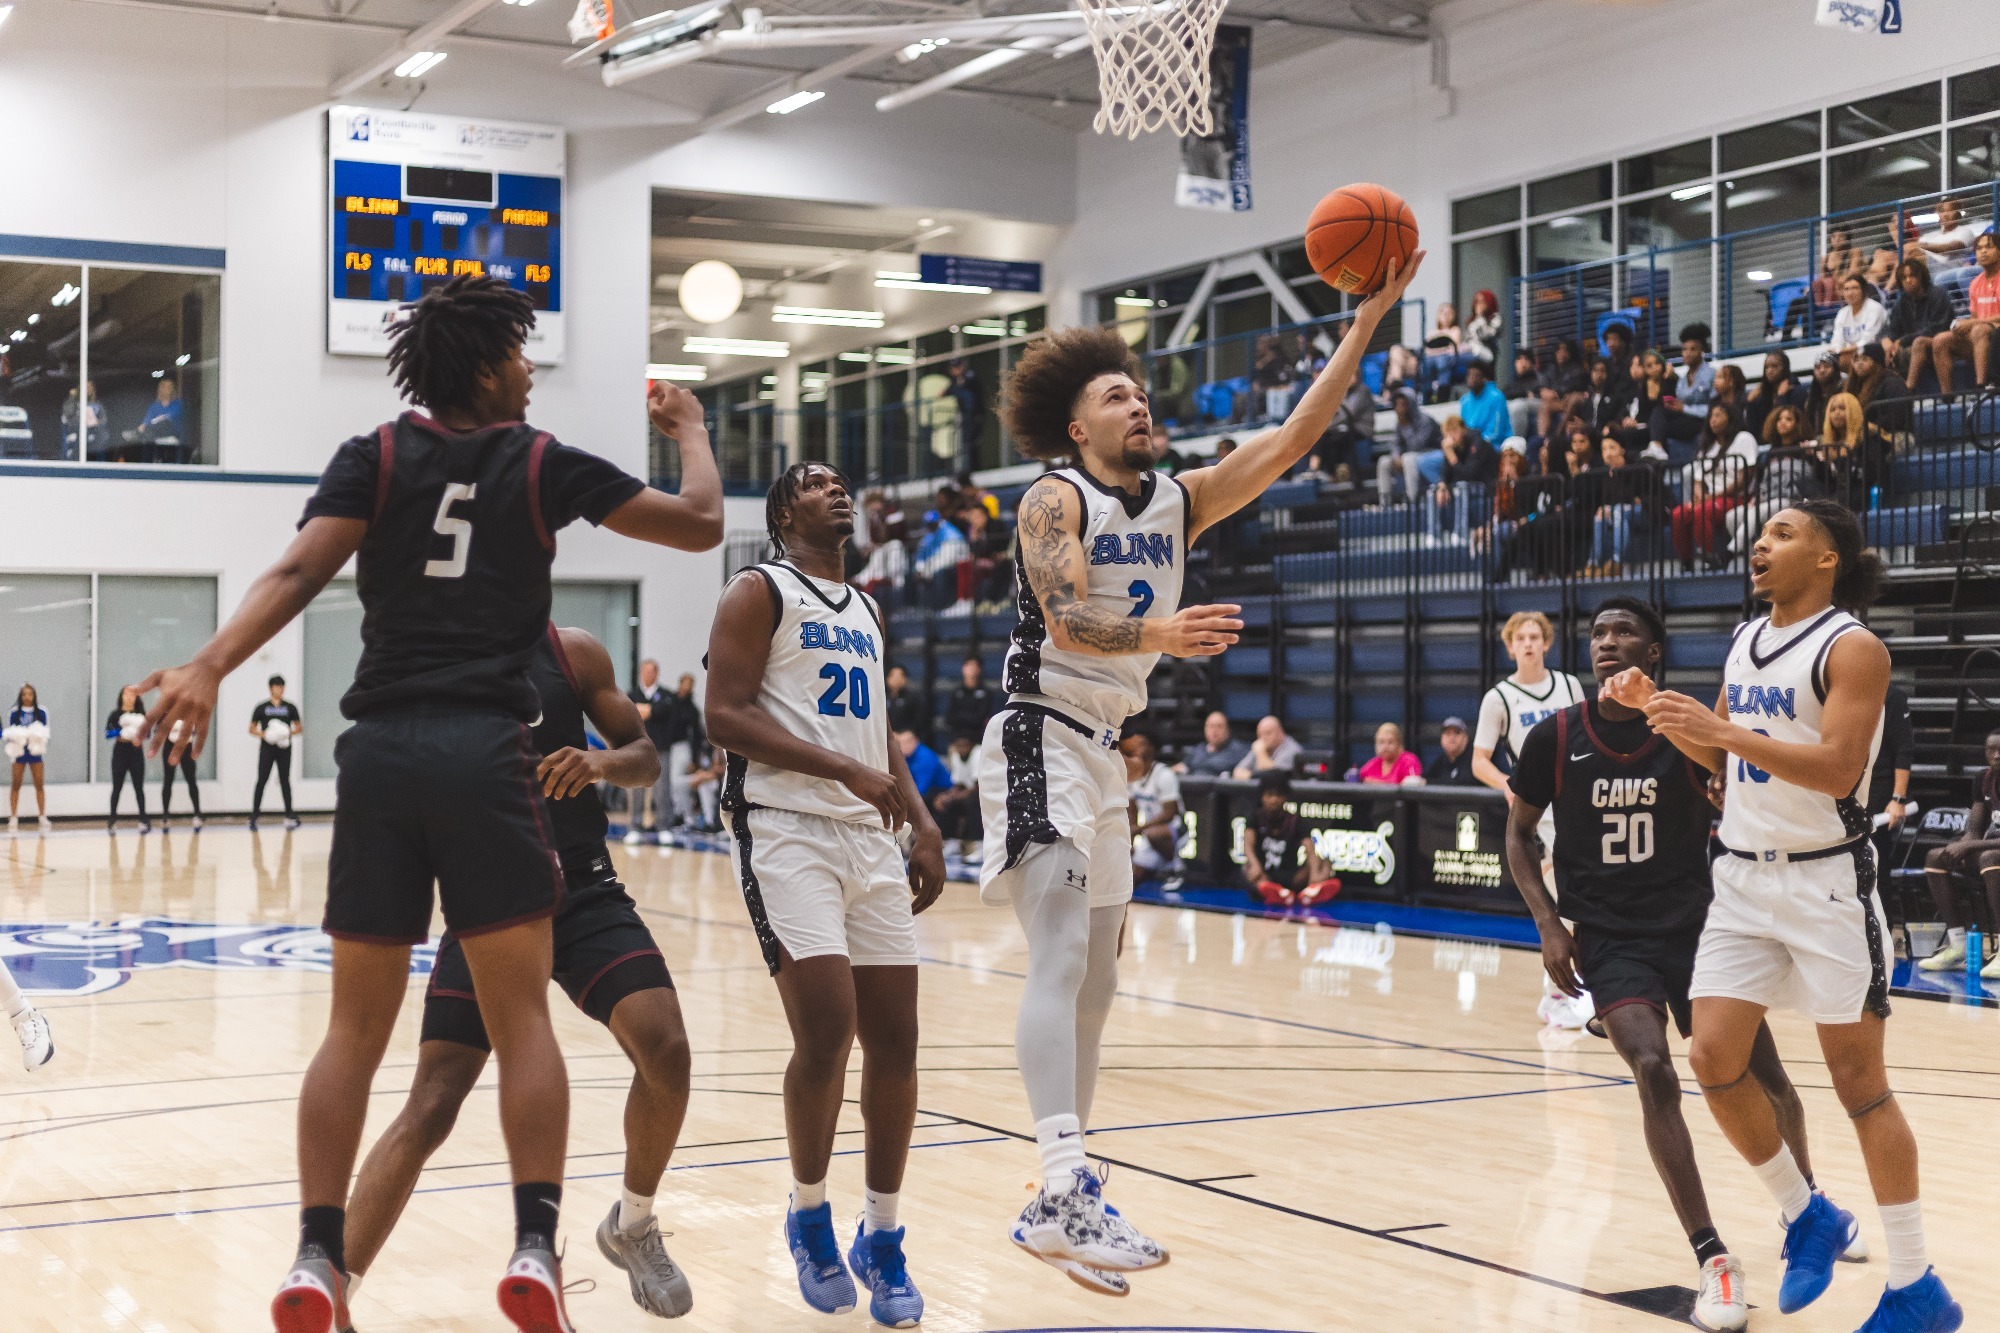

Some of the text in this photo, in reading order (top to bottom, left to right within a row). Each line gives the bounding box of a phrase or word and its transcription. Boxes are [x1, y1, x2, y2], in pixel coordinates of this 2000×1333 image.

[345, 252, 372, 271] FLS
[525, 264, 551, 283] FLS
[423, 482, 477, 578] 5
[1091, 532, 1174, 570] BLINN
[1127, 579, 1155, 617] 2
[800, 621, 878, 663] BLINN
[817, 662, 871, 720] 20
[1727, 684, 1795, 721] BLINN
[1299, 802, 1353, 819] COLLEGE
[1591, 777, 1658, 808] CAVS
[1601, 812, 1654, 865] 20
[1924, 811, 1969, 832] BLINN
[1461, 851, 1500, 864] COLLEGE
